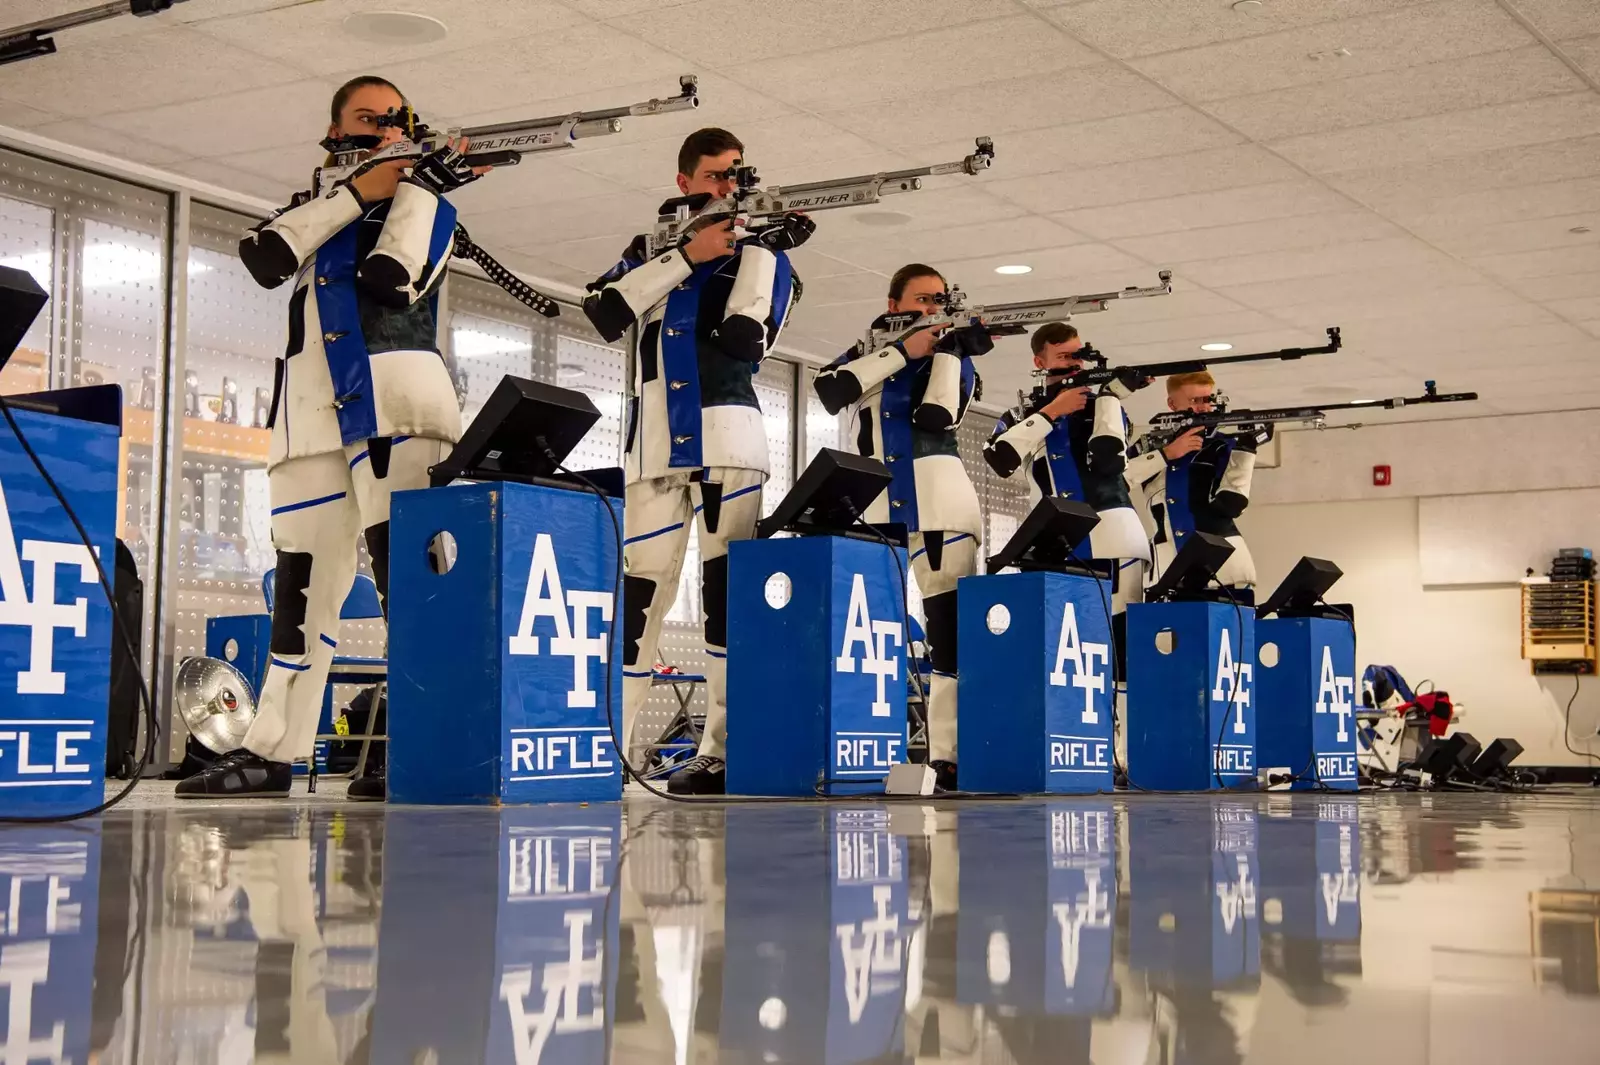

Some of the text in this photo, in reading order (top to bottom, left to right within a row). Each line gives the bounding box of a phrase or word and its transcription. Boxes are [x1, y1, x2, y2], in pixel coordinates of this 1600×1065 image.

[469, 134, 538, 151] WALTHER
[788, 193, 850, 208] WALTHER
[991, 310, 1047, 322] WALTHER
[511, 736, 613, 771] RIFLE
[837, 740, 902, 766] RIFLE
[1050, 743, 1108, 766] RIFLE
[1213, 750, 1252, 770] RIFLE
[1317, 757, 1355, 776] RIFLE
